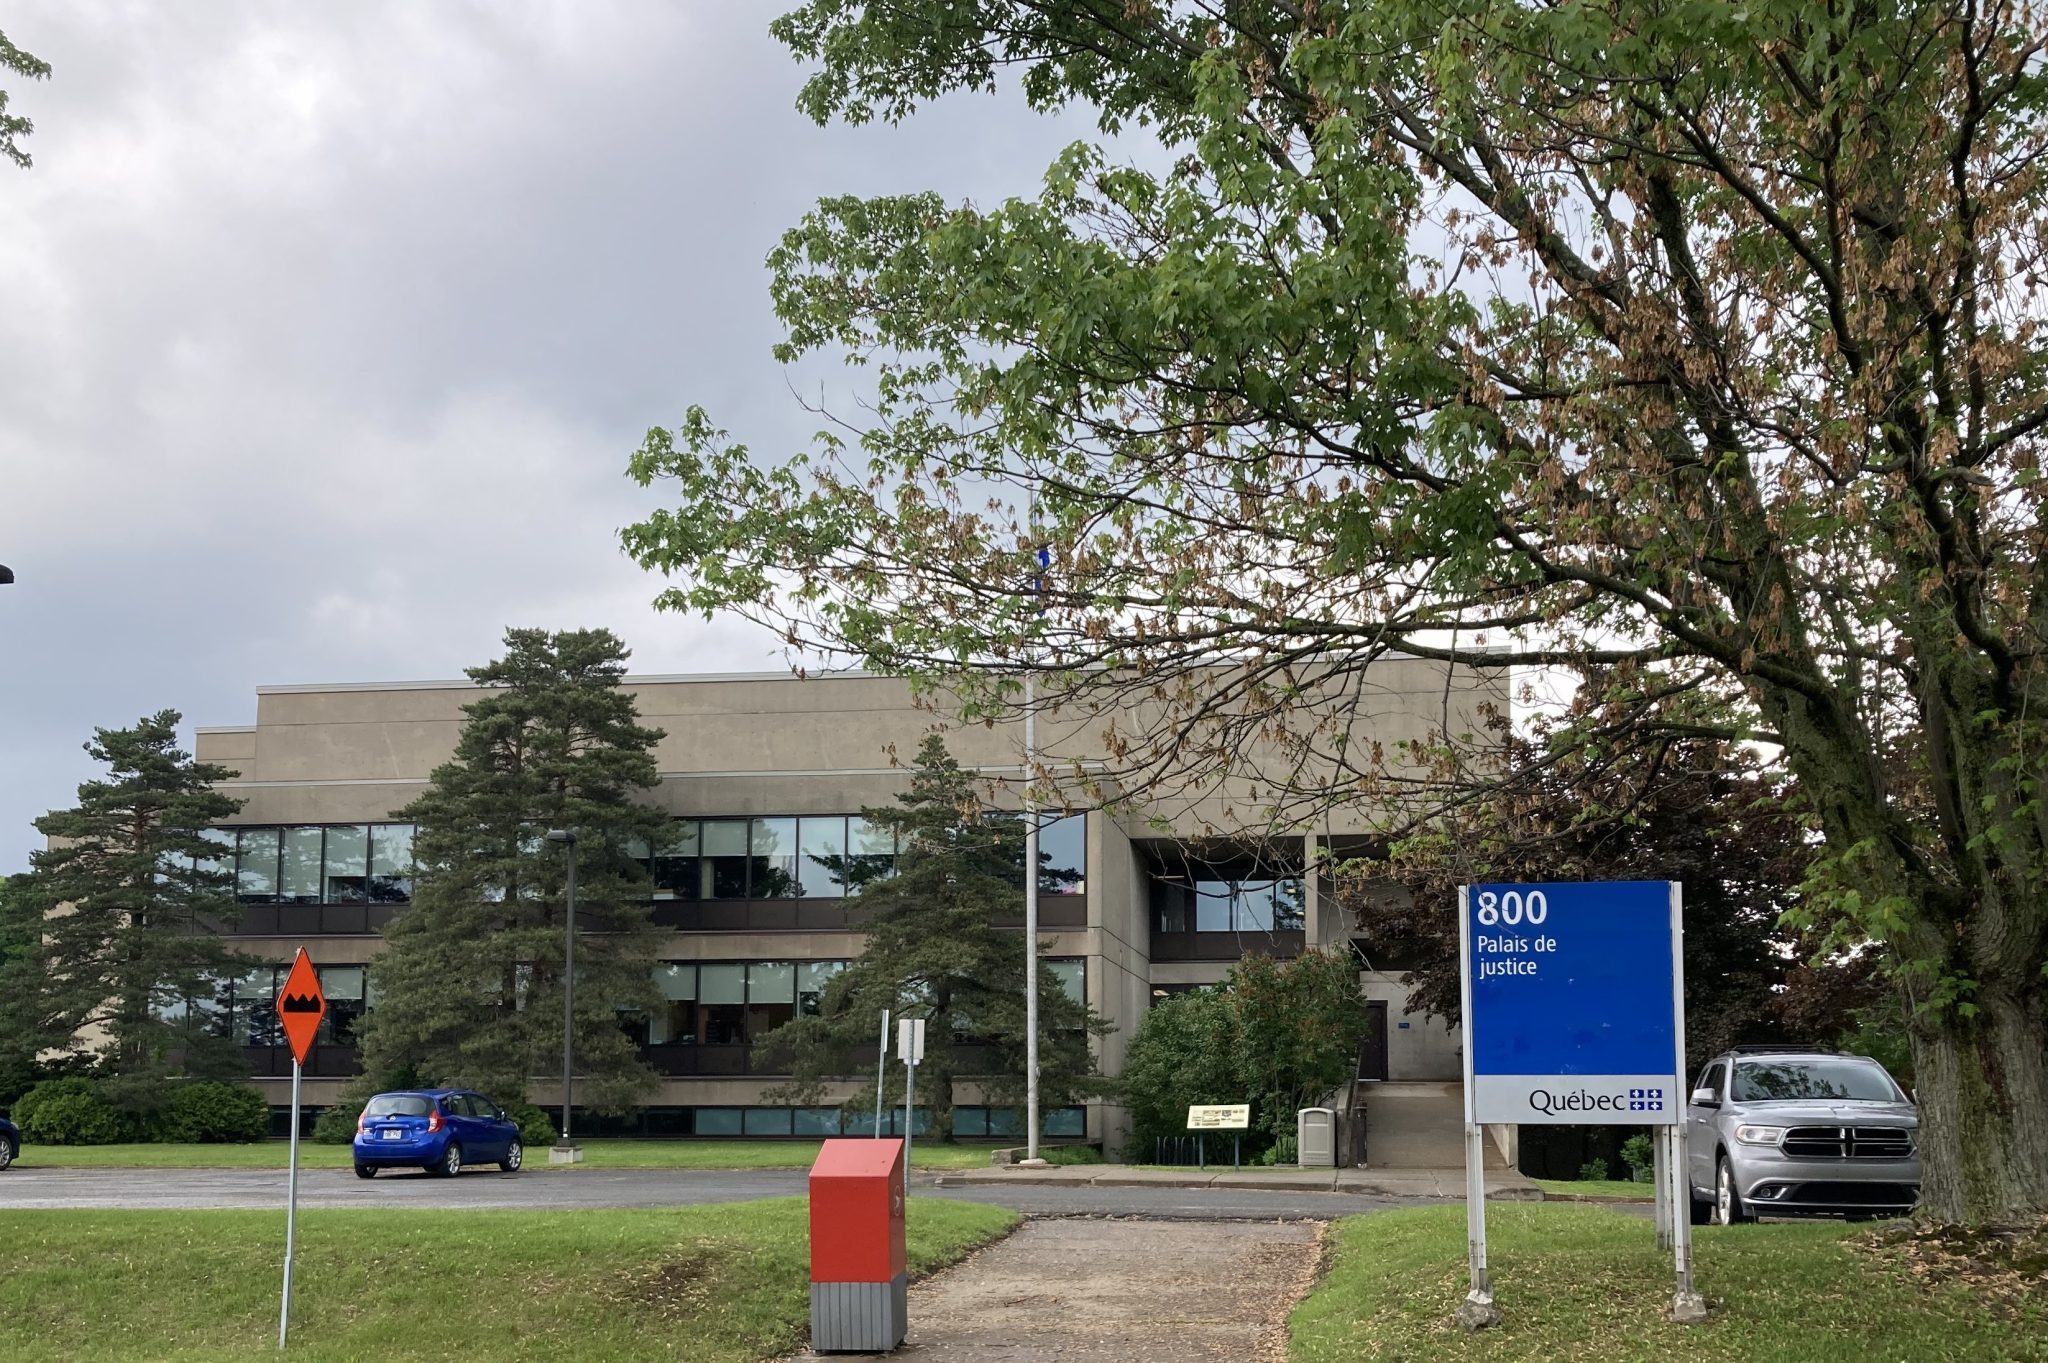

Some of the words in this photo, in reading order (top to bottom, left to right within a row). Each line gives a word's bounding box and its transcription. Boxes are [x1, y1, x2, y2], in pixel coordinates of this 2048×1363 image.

[1477, 890, 1548, 926] 800
[1478, 935, 1529, 953] Palais
[1534, 934, 1557, 953] de
[1479, 958, 1537, 980] justice
[1529, 1088, 1626, 1117] Québec
